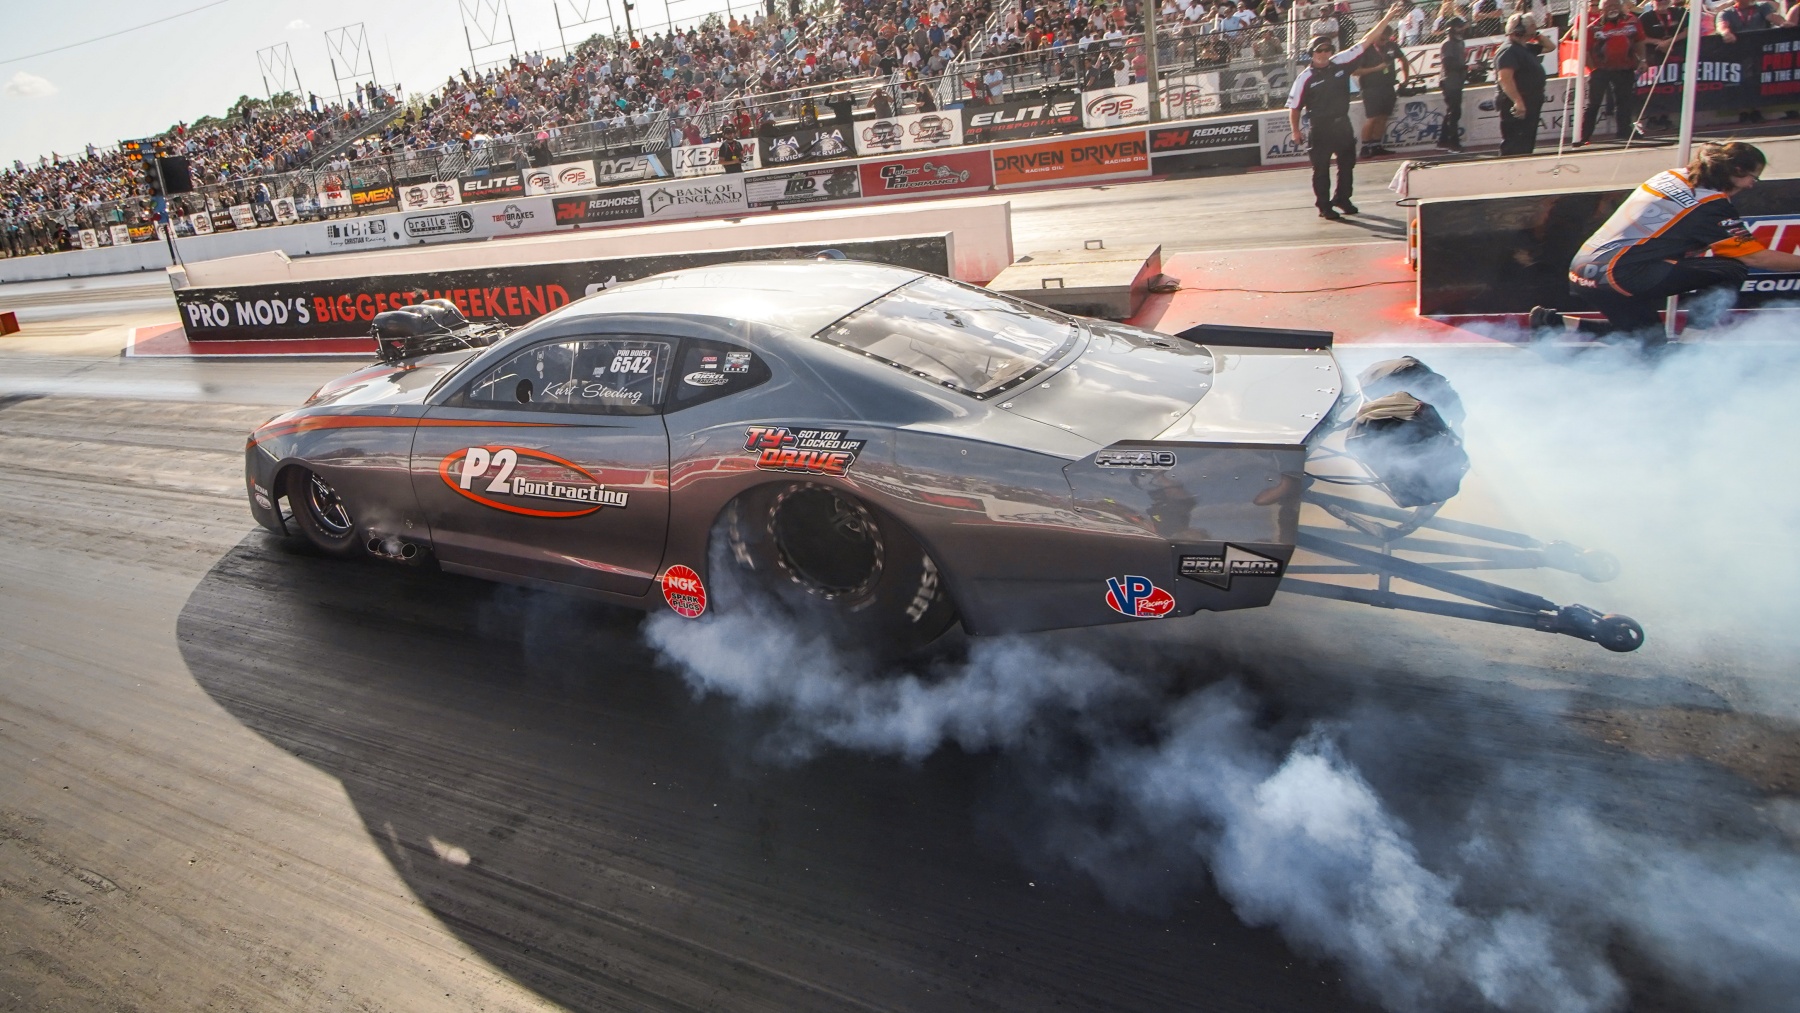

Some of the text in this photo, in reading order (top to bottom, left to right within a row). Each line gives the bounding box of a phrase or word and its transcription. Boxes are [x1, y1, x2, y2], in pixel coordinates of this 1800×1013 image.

[1636, 63, 1678, 87] ORLD
[970, 101, 1076, 127] ELITE
[1100, 99, 1134, 117] PJS
[811, 129, 845, 146] J&A
[1193, 124, 1253, 137] REDHORSE
[769, 136, 800, 151] J&A
[1190, 136, 1249, 145] PERFORMANCE
[769, 152, 804, 162] SERVICE
[811, 147, 848, 157] SERVICE
[1071, 140, 1148, 165] DRIVEN
[994, 150, 1065, 173] DRIVEN
[1025, 165, 1050, 174] RACING
[464, 175, 520, 191] ELITE
[534, 177, 550, 187] PJS
[567, 172, 586, 184] PJS
[885, 176, 959, 190] PERFORMANCE
[676, 184, 733, 197] BANK OF
[589, 196, 640, 209] REDHORSE
[678, 191, 743, 205] ENGLAND
[587, 207, 639, 218] PERFORMANCE
[409, 216, 447, 229] braille
[344, 237, 365, 245] CHRISTIAN
[188, 302, 230, 328] PRO
[236, 298, 311, 326] MOD'S
[629, 349, 651, 357] BOOST
[610, 357, 652, 374] 6542
[541, 382, 643, 405] Kurt Steding
[745, 427, 797, 451] TY-
[798, 430, 841, 441] GOT YOU
[801, 439, 861, 450] LOCKED UP!
[757, 448, 850, 474] DRIVE
[459, 447, 518, 494] P2
[512, 476, 629, 508] Contracting
[1182, 560, 1278, 571] PRO MOD
[668, 576, 697, 593] NGK
[671, 592, 699, 603] SPARK
[1106, 575, 1154, 616] VP
[672, 600, 700, 611] PLUGS
[1138, 598, 1173, 612] Racing
